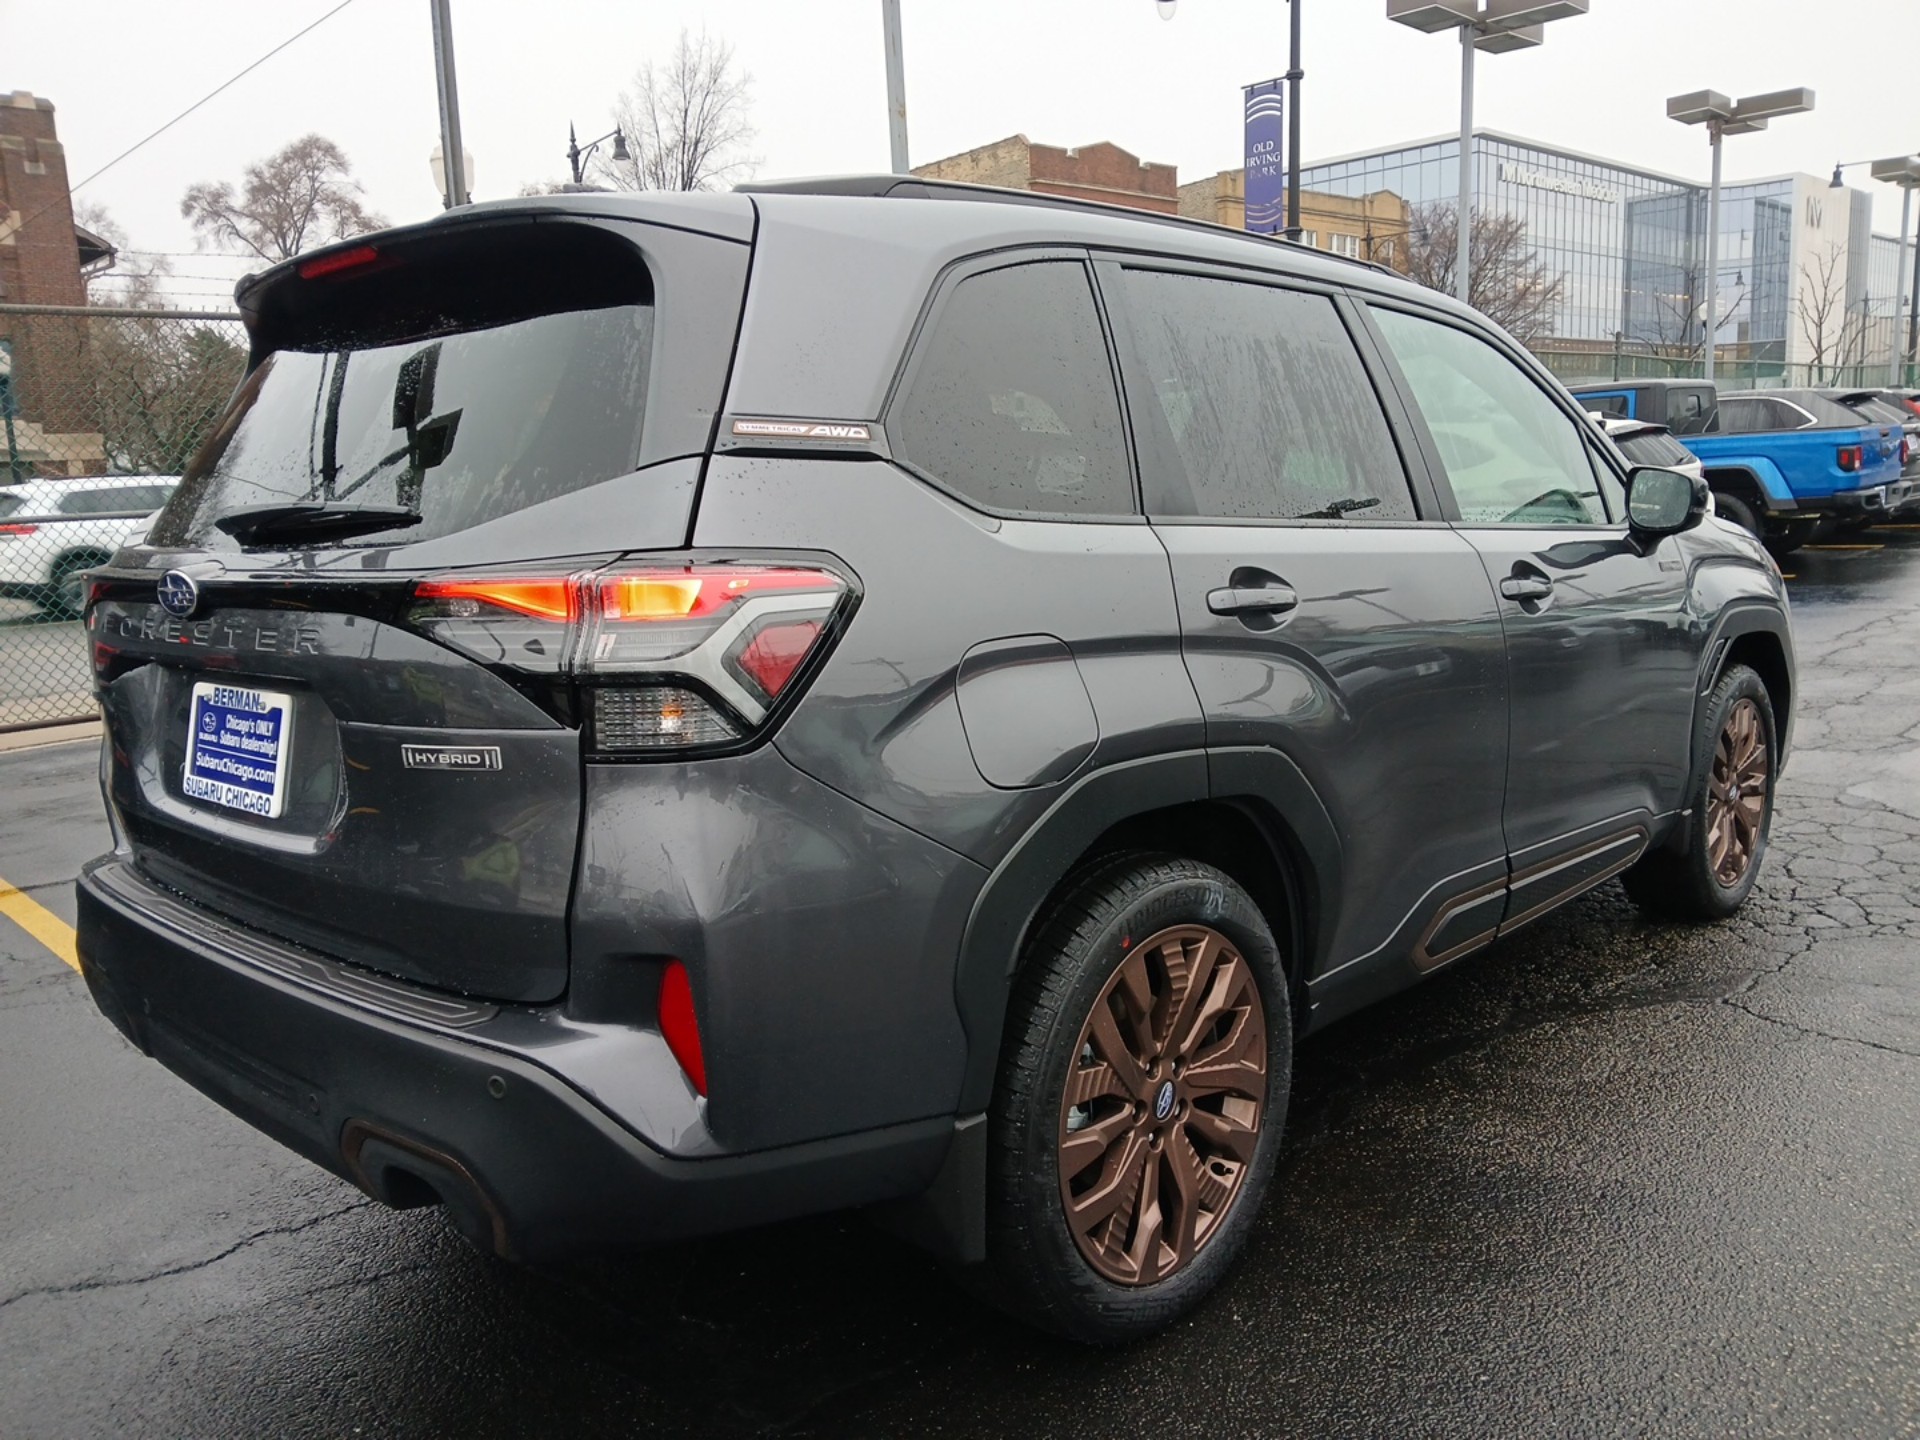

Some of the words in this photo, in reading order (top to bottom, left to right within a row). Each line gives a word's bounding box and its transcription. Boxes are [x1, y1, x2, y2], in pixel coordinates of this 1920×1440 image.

[1253, 140, 1274, 154] OLD
[1246, 151, 1281, 168] IRVING
[809, 425, 867, 439] AWD
[103, 616, 319, 656] FORESTER
[213, 687, 260, 711] BERMAN
[226, 714, 256, 735] Chicago's
[255, 721, 274, 737] ONLY
[220, 730, 242, 748] Subaru
[241, 737, 277, 758] dealership!
[196, 752, 275, 784] SubaruChicago.com
[415, 752, 481, 765] HYBRID
[185, 777, 223, 801] SUBARU
[225, 786, 272, 815] CHICAGO
